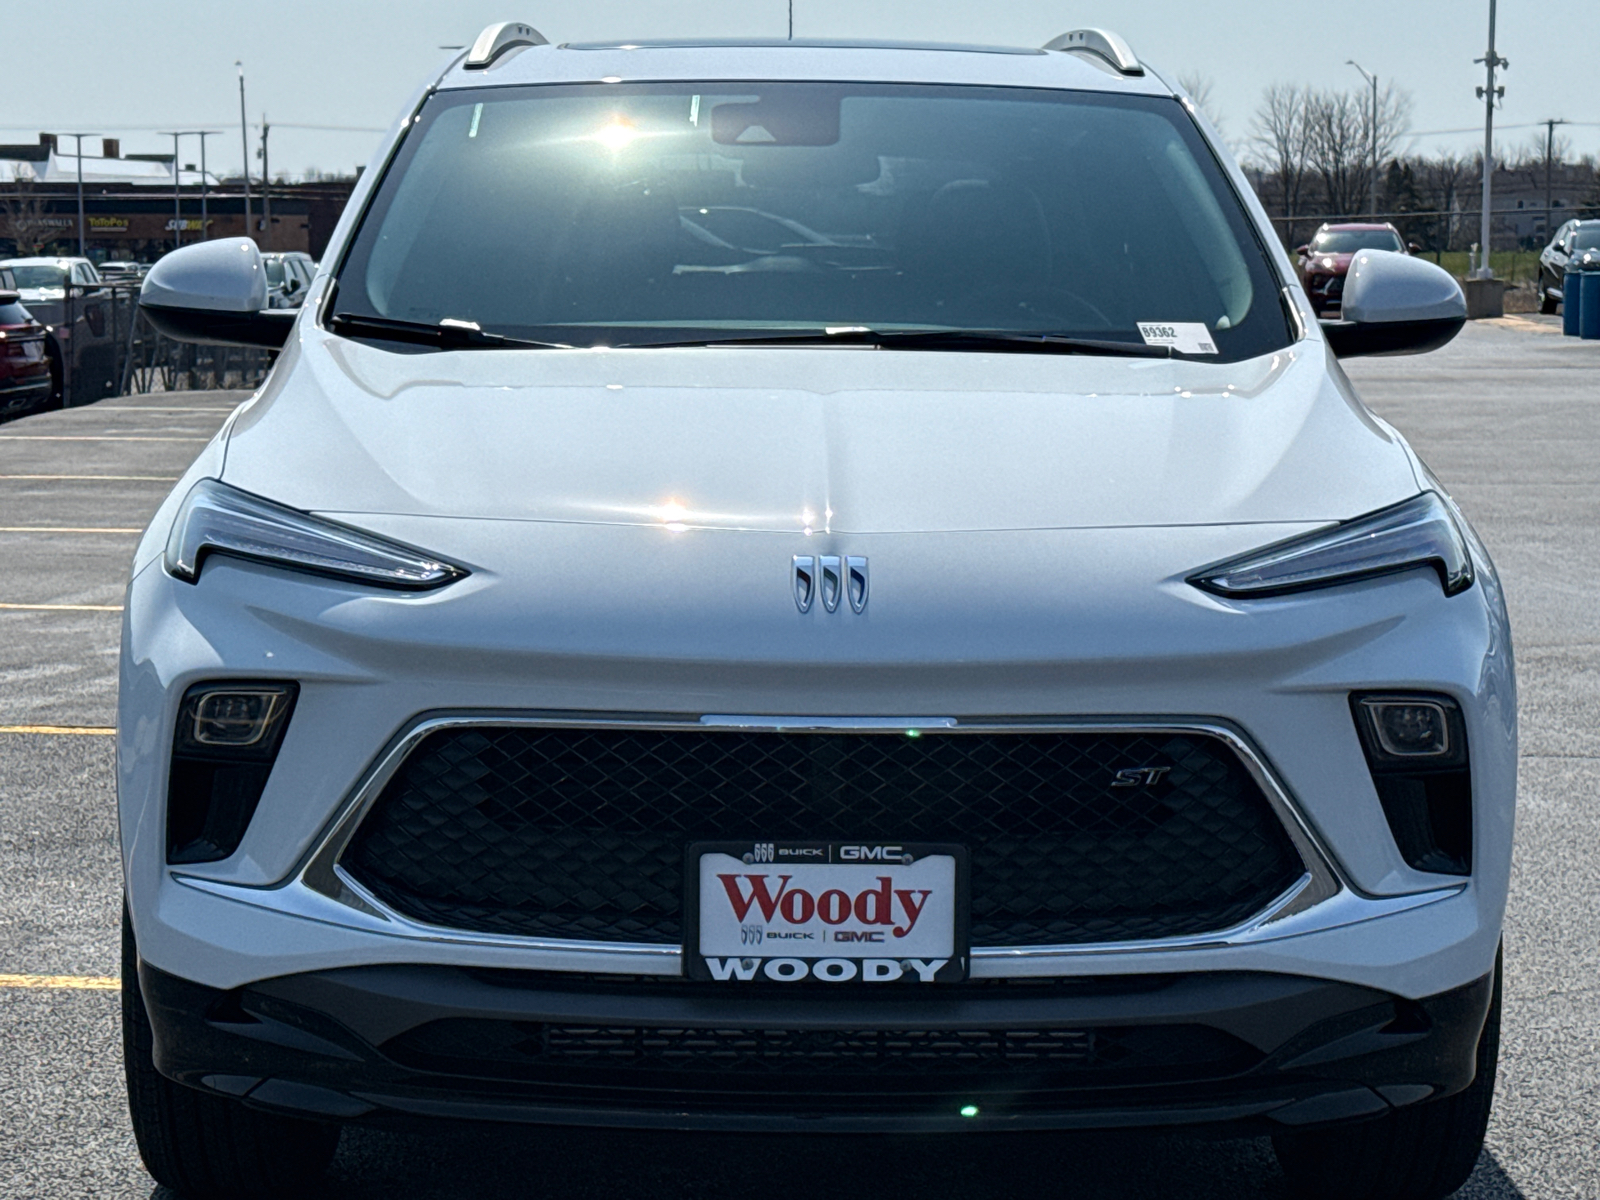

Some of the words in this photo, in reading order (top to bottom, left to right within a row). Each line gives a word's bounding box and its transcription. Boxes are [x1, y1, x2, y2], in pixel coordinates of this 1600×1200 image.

[1111, 766, 1171, 787] ST
[778, 848, 824, 857] BUICK
[840, 845, 903, 860] GMC
[717, 873, 933, 938] Woody
[766, 931, 815, 940] BUICK
[834, 930, 885, 943] GMC
[704, 957, 950, 982] WOODY
